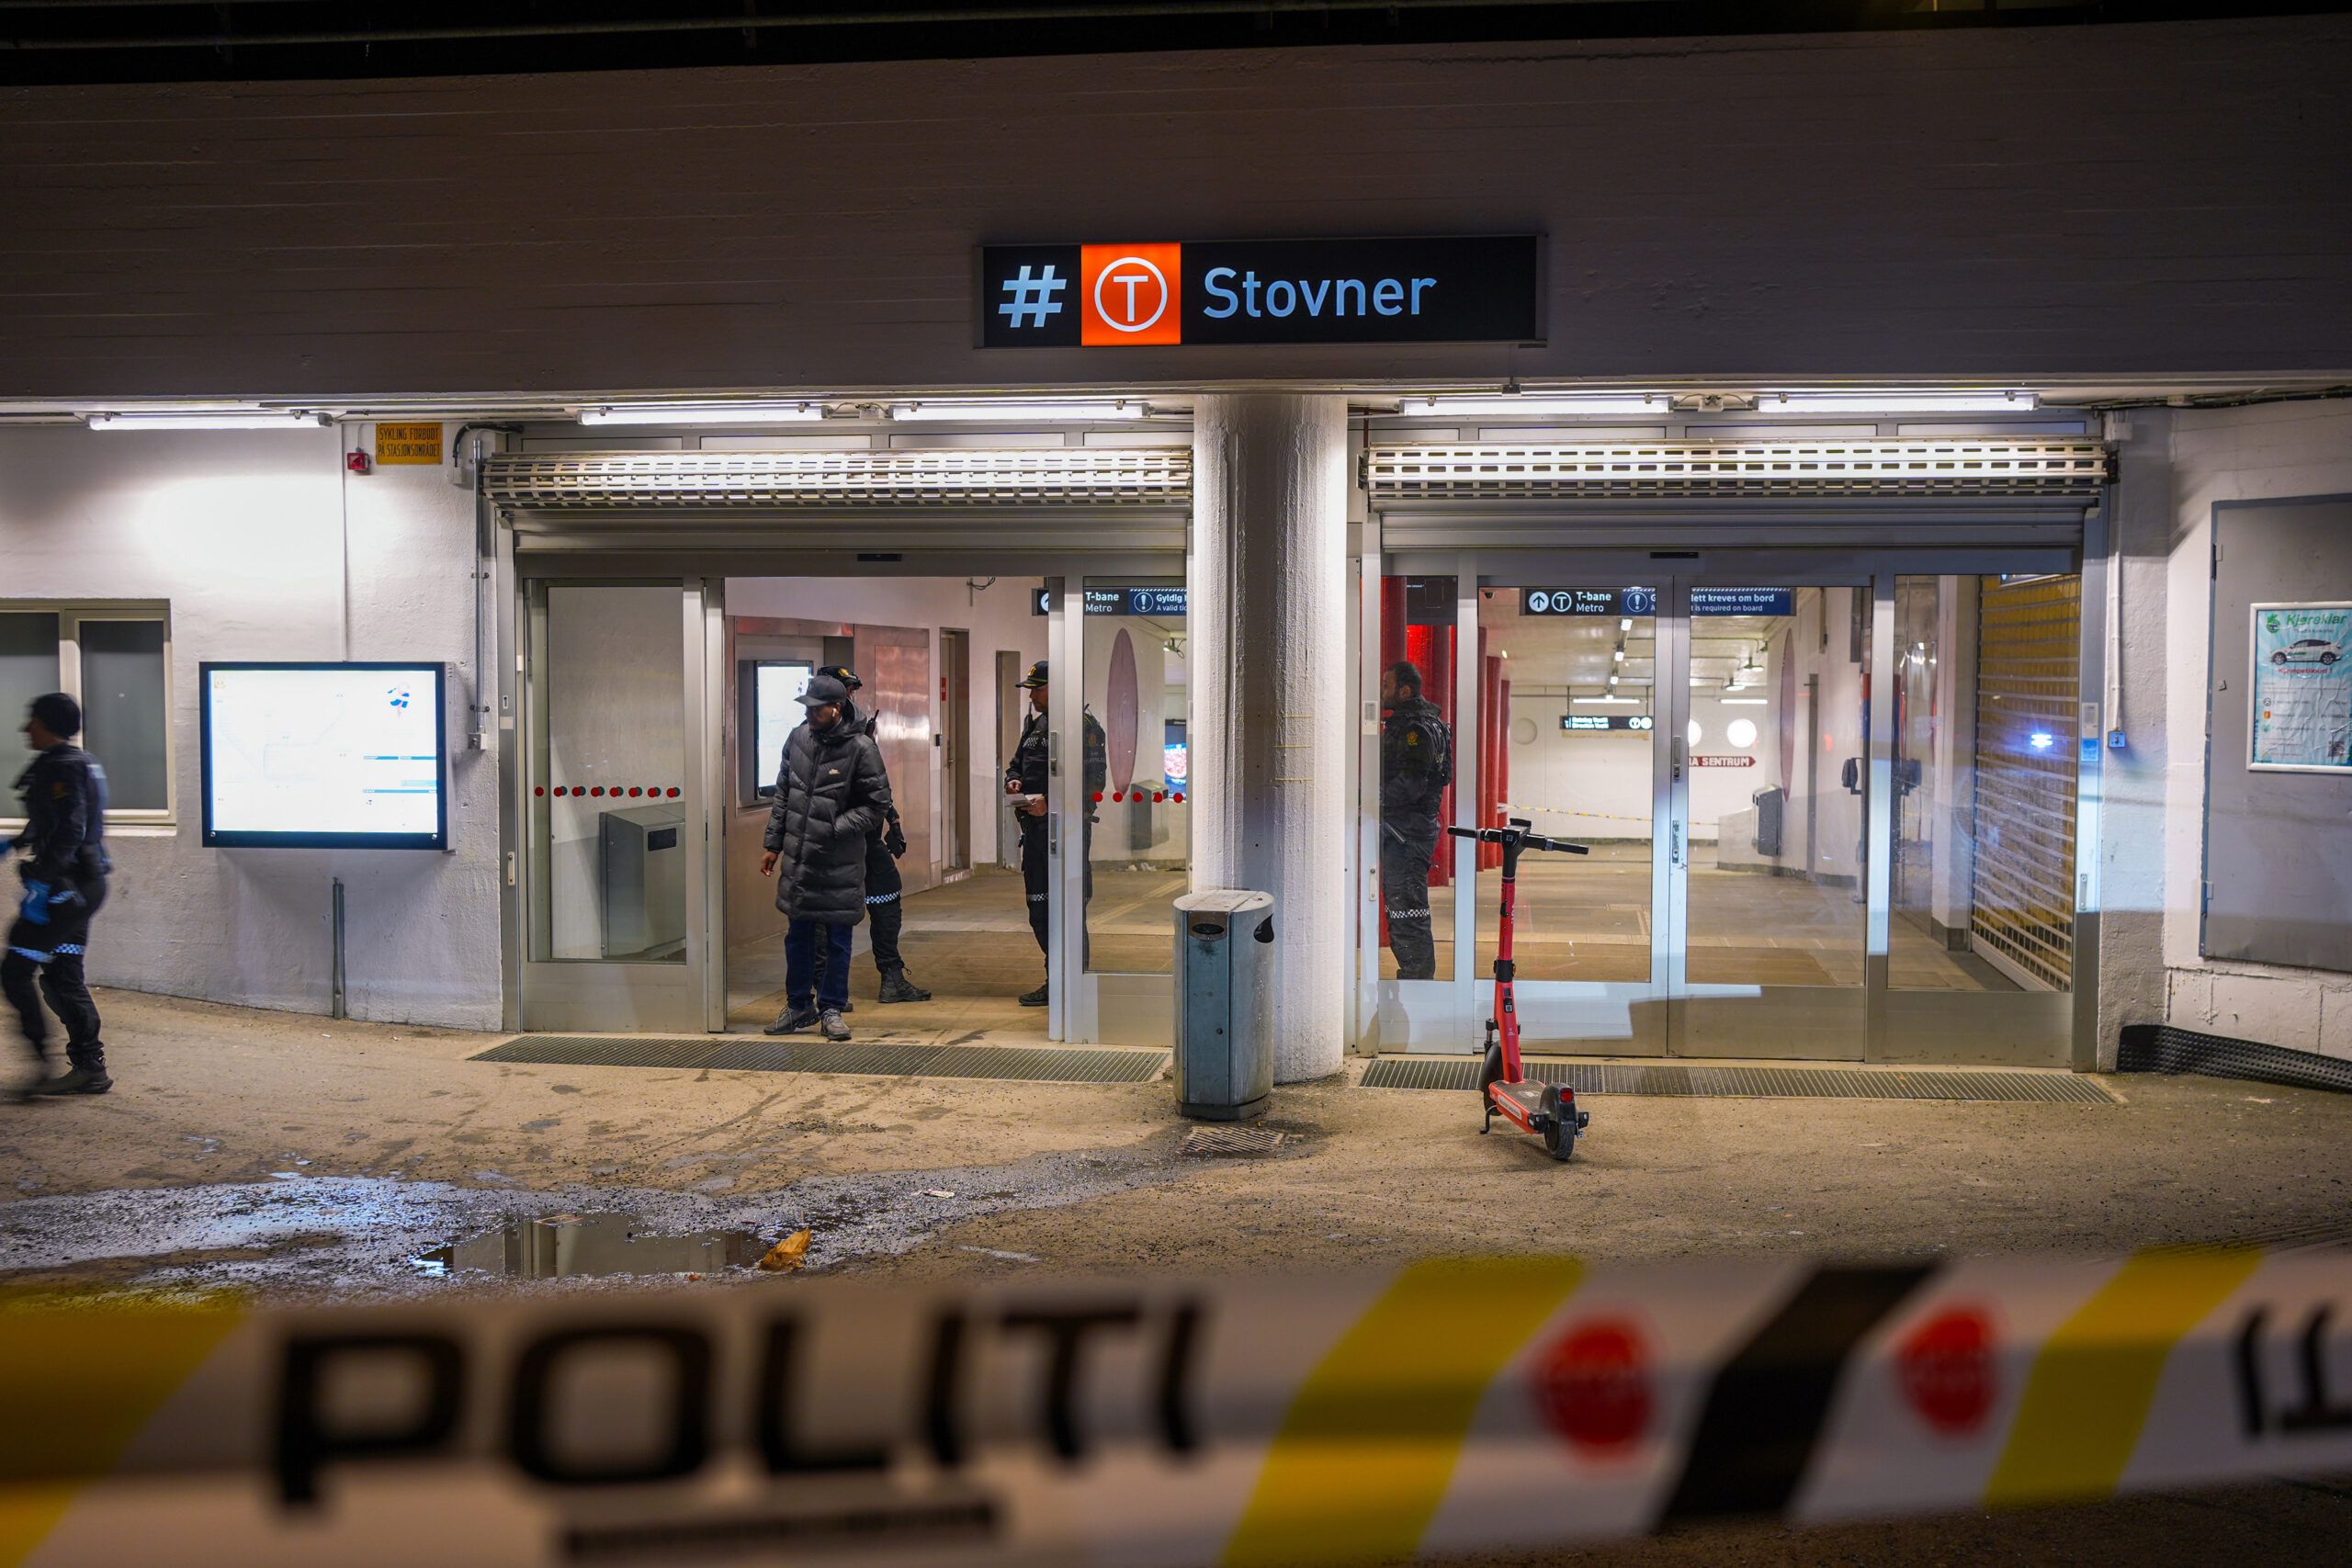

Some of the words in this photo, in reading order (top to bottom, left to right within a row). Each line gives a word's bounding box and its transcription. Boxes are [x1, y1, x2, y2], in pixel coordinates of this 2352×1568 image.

[1202, 266, 1437, 319] Stovner
[379, 427, 407, 440] SYKLING
[410, 427, 439, 440] FORBUDT
[379, 443, 385, 457] PÅ
[387, 442, 440, 457] STASJONSOMRÅDET
[1085, 592, 1120, 601] T-bane
[1156, 593, 1182, 604] Gyldig
[1576, 591, 1611, 602] T-bane
[1690, 593, 1706, 603] lett
[1708, 593, 1736, 603] kreves
[1754, 593, 1774, 603] bord
[1085, 604, 1113, 613] Metro
[1576, 603, 1604, 613] Metro
[1702, 604, 1731, 614] required
[1702, 757, 1749, 766] SENTRUM
[274, 1301, 1204, 1508] POLITI
